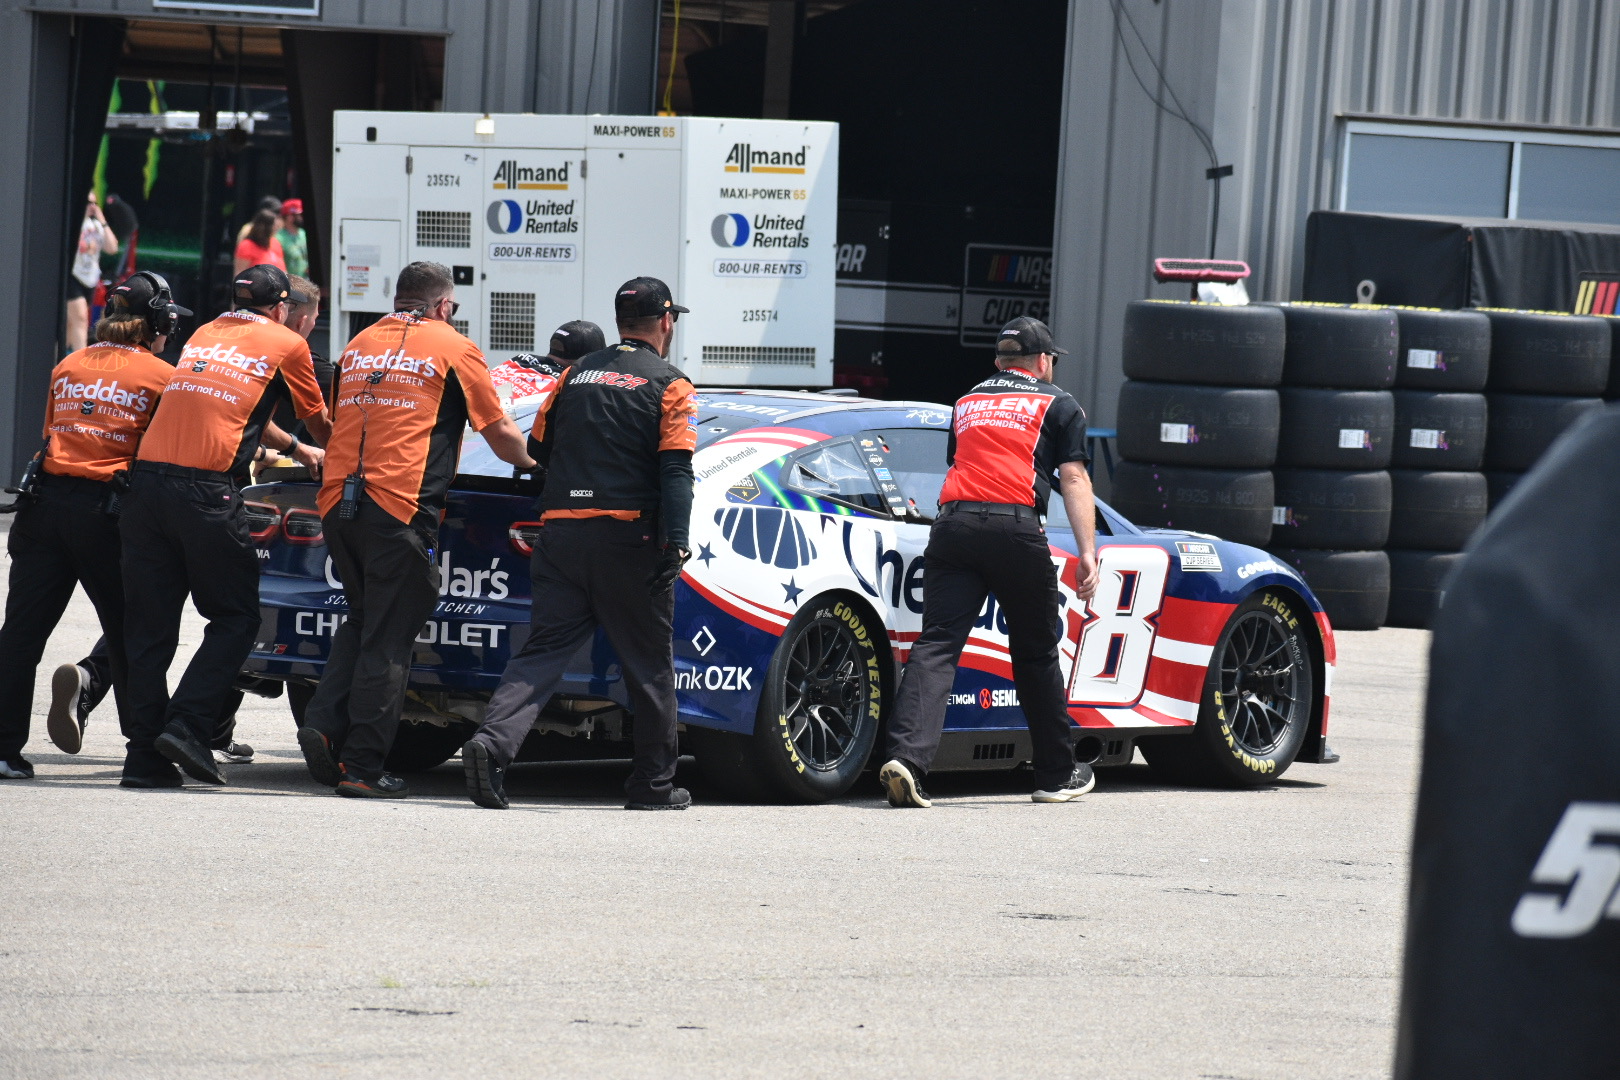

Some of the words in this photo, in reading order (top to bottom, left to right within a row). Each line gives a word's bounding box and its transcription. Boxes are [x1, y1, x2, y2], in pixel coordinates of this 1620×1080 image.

[593, 125, 660, 138] MAXI-POWER
[662, 127, 676, 138] 65
[725, 143, 806, 173] Allmand
[427, 174, 461, 188] 235574
[493, 160, 568, 190] Allmand
[720, 187, 791, 200] MAXI-POWER
[793, 189, 807, 200] 65
[526, 199, 575, 216] United
[525, 217, 578, 234] Rentals
[753, 214, 806, 231] United
[753, 232, 809, 249] Rentals
[493, 246, 572, 259] 800-UR-RENTS
[718, 262, 802, 275] 800-UR-RENTS
[742, 309, 778, 323] 235574
[342, 349, 437, 378] Cheddar's
[209, 364, 251, 385] KITCHEN
[385, 373, 424, 387] KITCHEN
[594, 372, 649, 390] RCR
[54, 377, 149, 412] Cheddar's
[181, 381, 197, 392] For
[196, 385, 214, 396] not
[214, 389, 221, 398] a
[222, 391, 238, 405] lot.
[377, 398, 392, 406] not
[401, 399, 417, 410] lot.
[956, 397, 1042, 422] WHELEN
[97, 405, 136, 422] KITCHEN
[981, 410, 992, 418] TO
[994, 411, 1035, 424] PROTECT
[73, 424, 89, 433] For
[88, 428, 104, 437] not
[113, 432, 128, 443] lot.
[970, 419, 1027, 431] RESPONDERS
[698, 462, 727, 480] United
[729, 446, 758, 465] Rentals
[570, 490, 593, 498] sparco
[1185, 556, 1196, 565] CUP
[1197, 557, 1214, 565] SERIES
[436, 601, 488, 615] TCHEN
[1261, 593, 1299, 630] EAGLE
[1068, 546, 1169, 706] 8
[704, 665, 753, 691] OZK
[992, 689, 1020, 707] SENI
[779, 714, 805, 774] EAGLE
